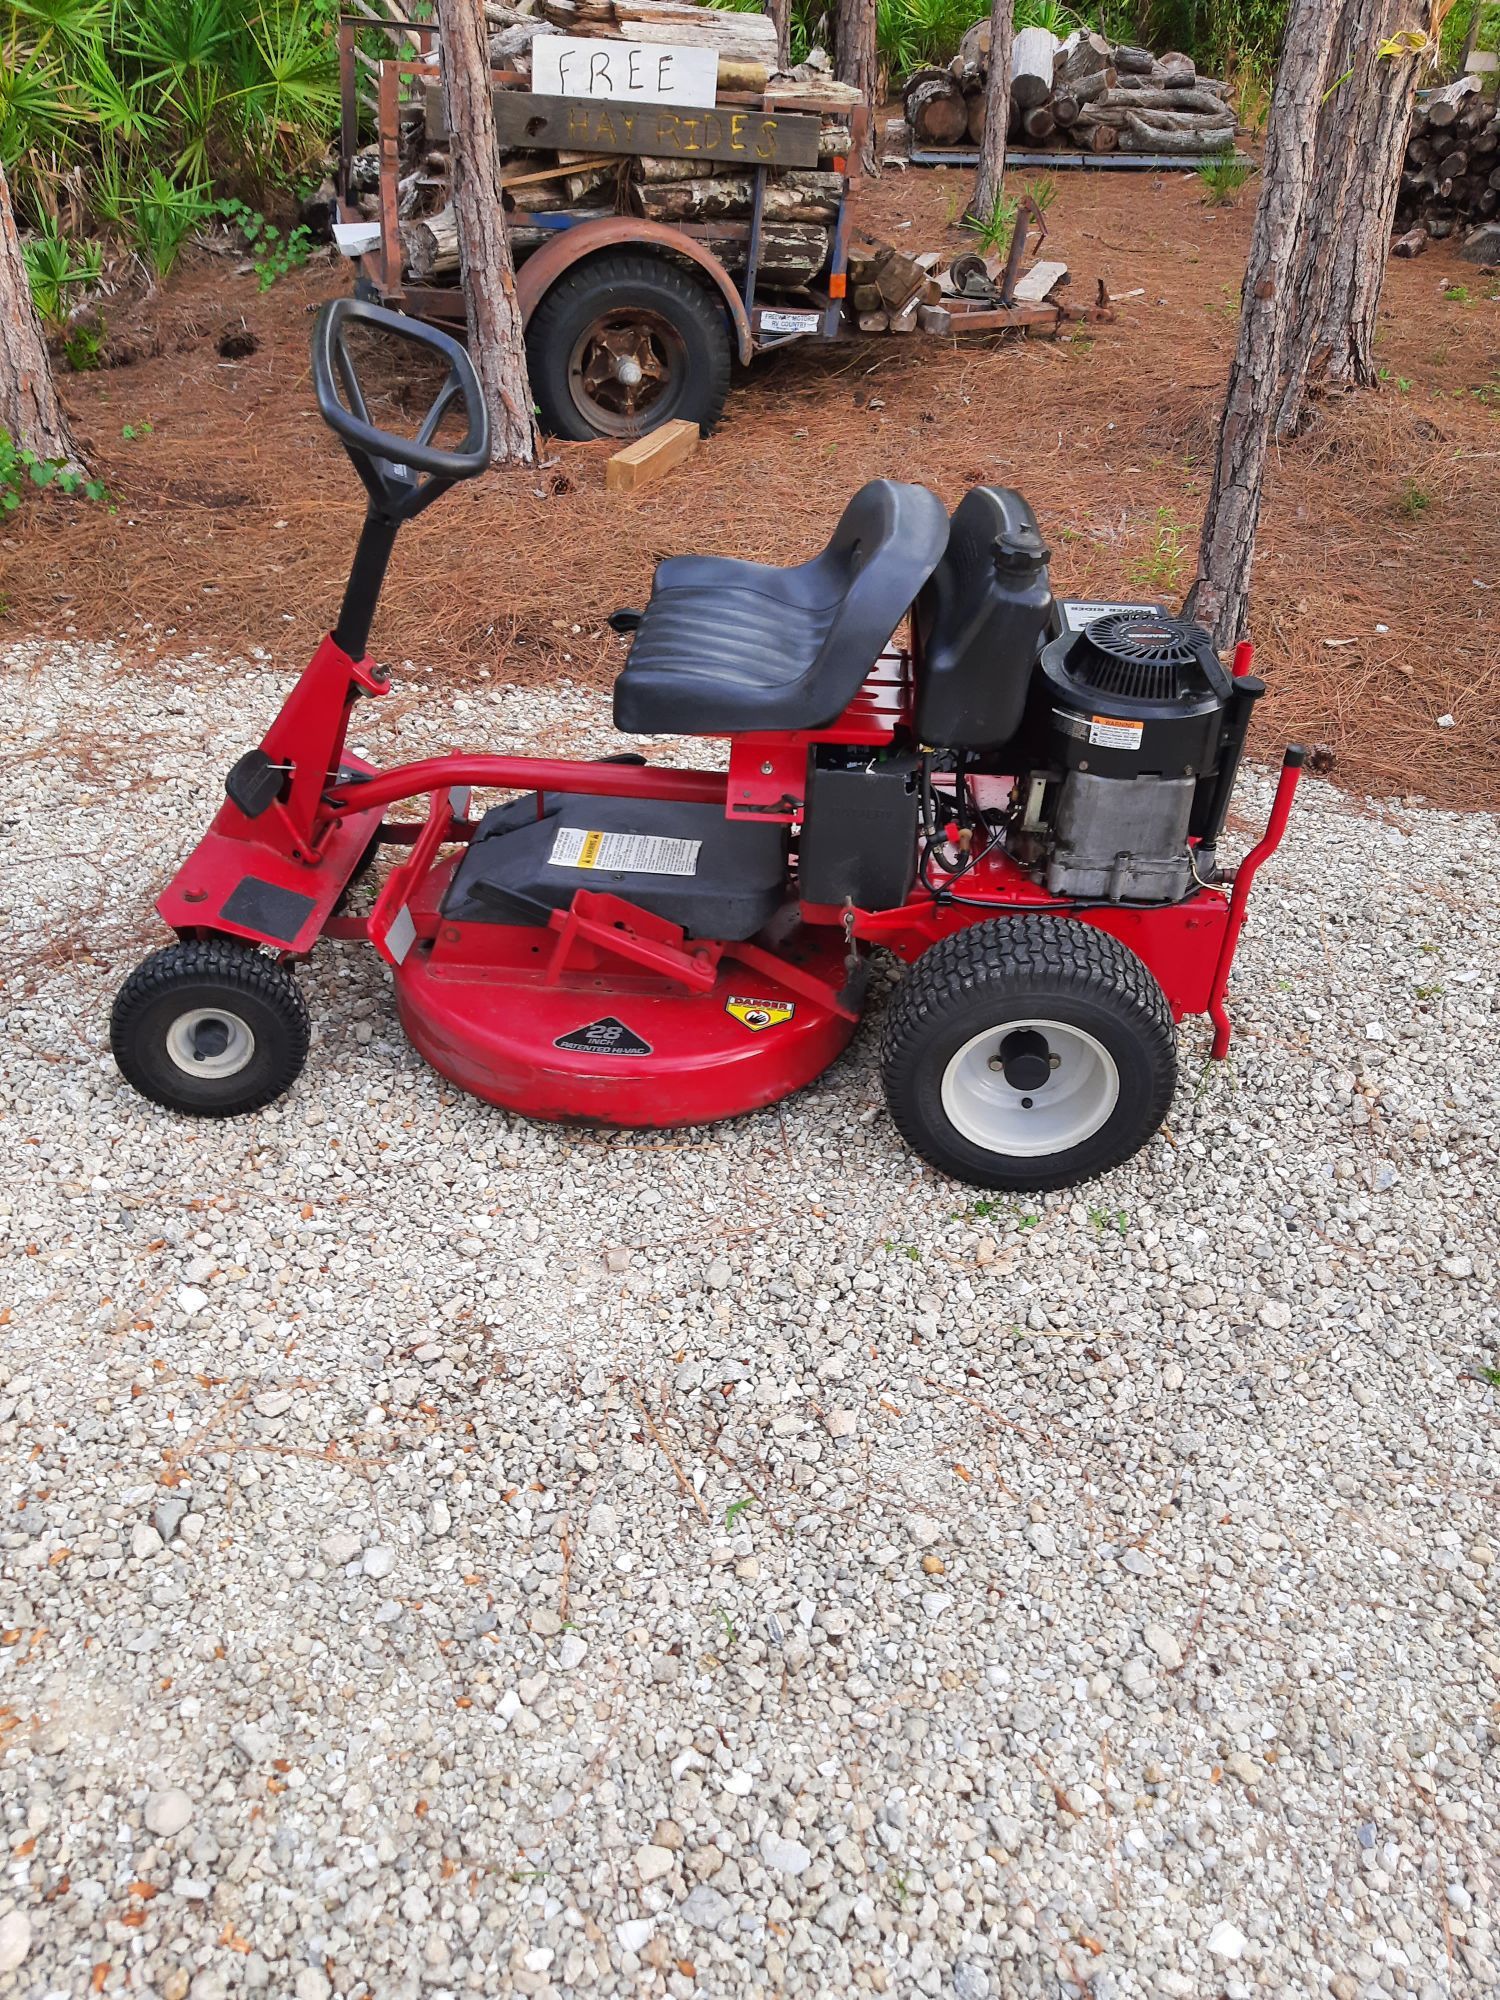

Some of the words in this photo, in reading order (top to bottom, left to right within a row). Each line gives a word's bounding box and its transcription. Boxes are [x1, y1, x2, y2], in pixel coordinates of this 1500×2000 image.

[558, 50, 674, 94] FREE
[568, 108, 639, 144] HAY
[656, 114, 778, 158] RIDES
[1104, 719, 1135, 729] WARNING
[734, 996, 788, 1010] DANGER
[585, 1025, 623, 1040] 28
[560, 1041, 610, 1053] PATENTED
